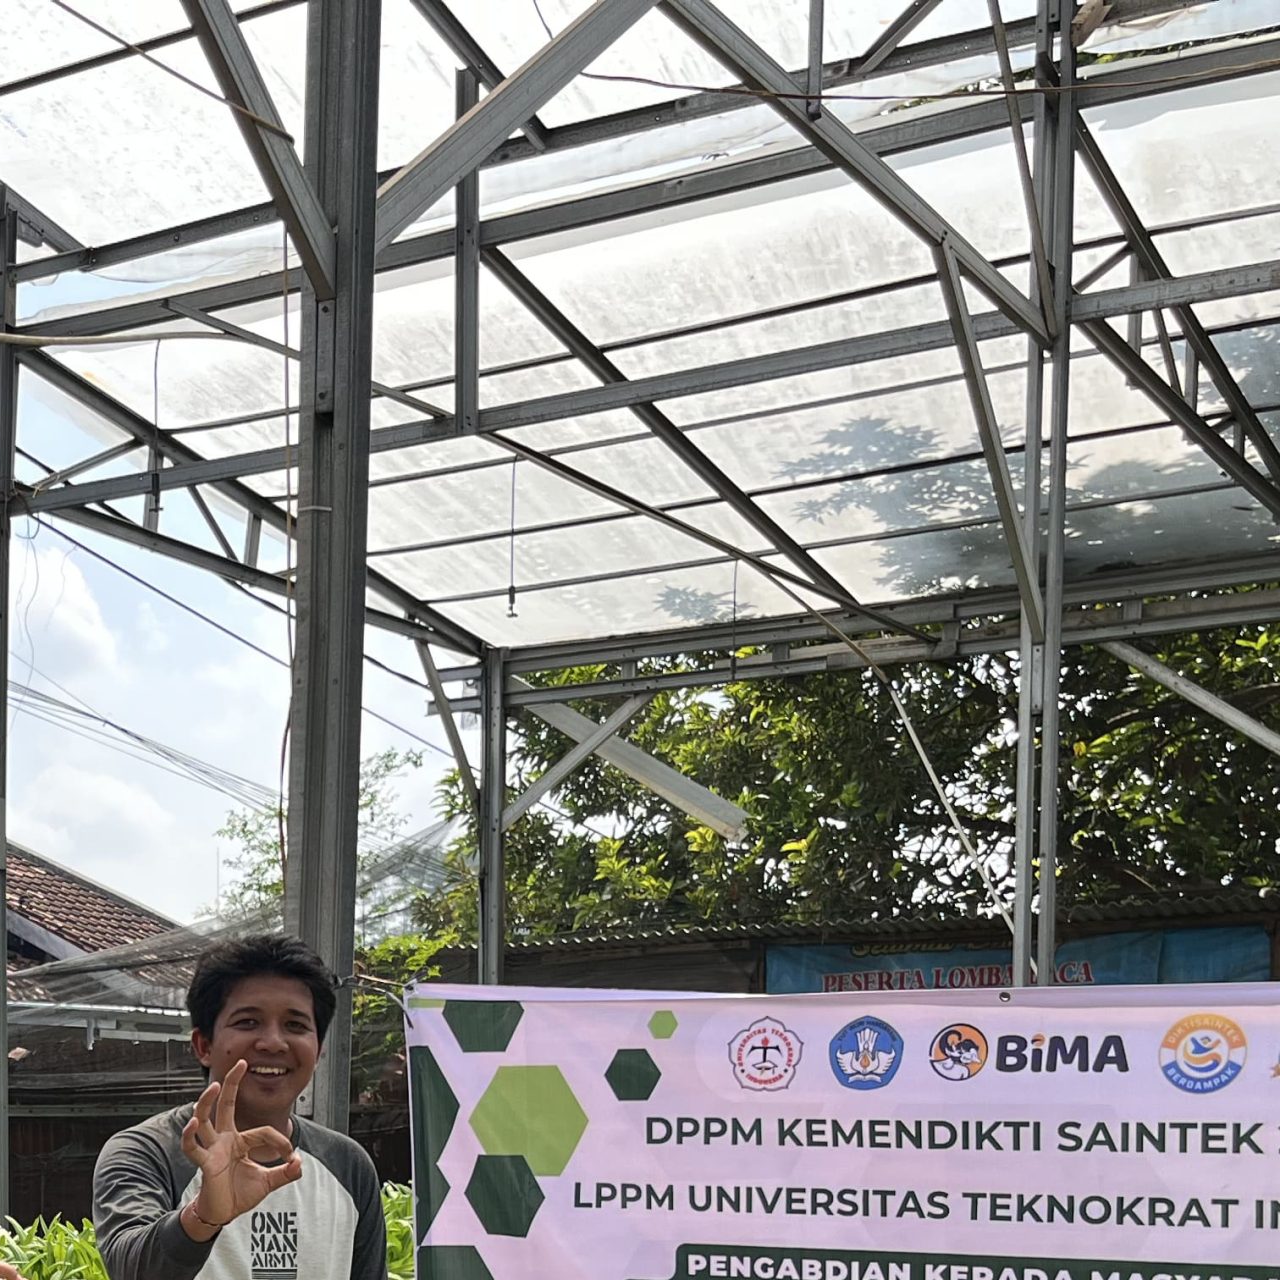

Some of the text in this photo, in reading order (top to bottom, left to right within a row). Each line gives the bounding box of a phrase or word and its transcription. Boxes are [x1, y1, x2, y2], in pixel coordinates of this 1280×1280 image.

[822, 968, 926, 993] PESERTA
[1030, 960, 1095, 984] CA
[1166, 1066, 1235, 1090] BERDAMPAK
[646, 1116, 763, 1146] DPPM
[777, 1119, 1041, 1152] KEMENDIKTI
[1057, 1121, 1264, 1154] SAINTEK
[574, 1182, 674, 1211] LPPM
[688, 1186, 950, 1220] UNIVERSITAS
[961, 1193, 1240, 1228] TEKNOKRAT
[251, 1212, 297, 1234] ONE
[251, 1233, 298, 1253] MAN
